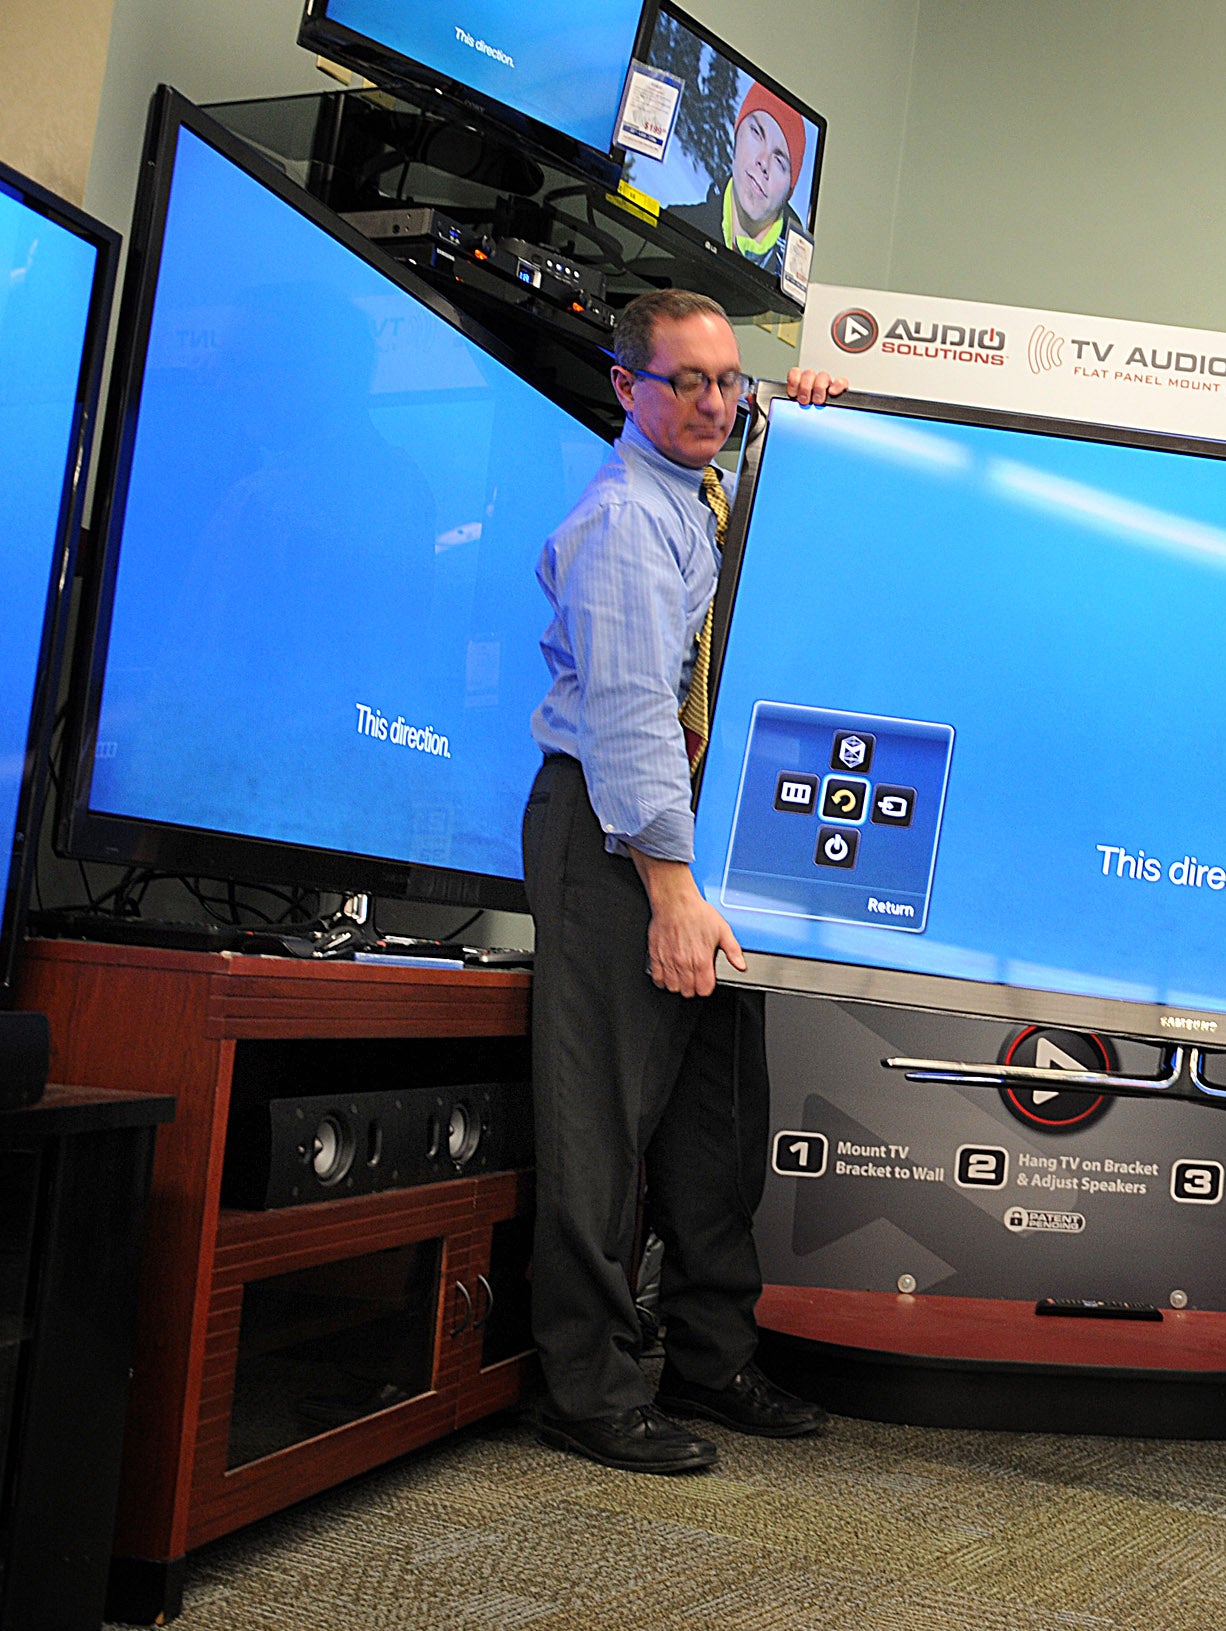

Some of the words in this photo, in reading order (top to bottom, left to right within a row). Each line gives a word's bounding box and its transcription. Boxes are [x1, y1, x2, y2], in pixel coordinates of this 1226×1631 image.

[455, 26, 474, 48] This
[475, 40, 515, 68] direction.
[884, 318, 1006, 351] AUDIO
[881, 341, 1005, 366] SOLUTIONS
[1071, 339, 1114, 362] TV
[1073, 366, 1109, 380] FLAT
[1114, 371, 1162, 386] PANEL
[1168, 378, 1221, 393] MOUNT
[356, 703, 388, 741] This
[390, 716, 451, 758] direction.
[1096, 844, 1161, 882] This
[867, 897, 914, 918] Return
[1160, 1016, 1218, 1033] SAMSUNG
[789, 1141, 809, 1166] 1
[837, 1141, 886, 1158] Mount
[888, 1145, 909, 1159] TV
[836, 1161, 892, 1179] Bracket
[894, 1165, 910, 1180] to
[913, 1166, 945, 1182] Wall
[967, 1154, 997, 1180] 2
[1018, 1154, 1057, 1172] Hang
[1059, 1156, 1080, 1171] TV
[1082, 1161, 1101, 1172] on
[1104, 1159, 1159, 1176] Bracket
[1017, 1173, 1029, 1186] &
[1031, 1174, 1079, 1192] Adjust
[1081, 1177, 1147, 1195] Speakers
[1183, 1169, 1212, 1194] 3
[1028, 1220, 1080, 1230] PENDING
[1029, 1212, 1081, 1224] PATENT
